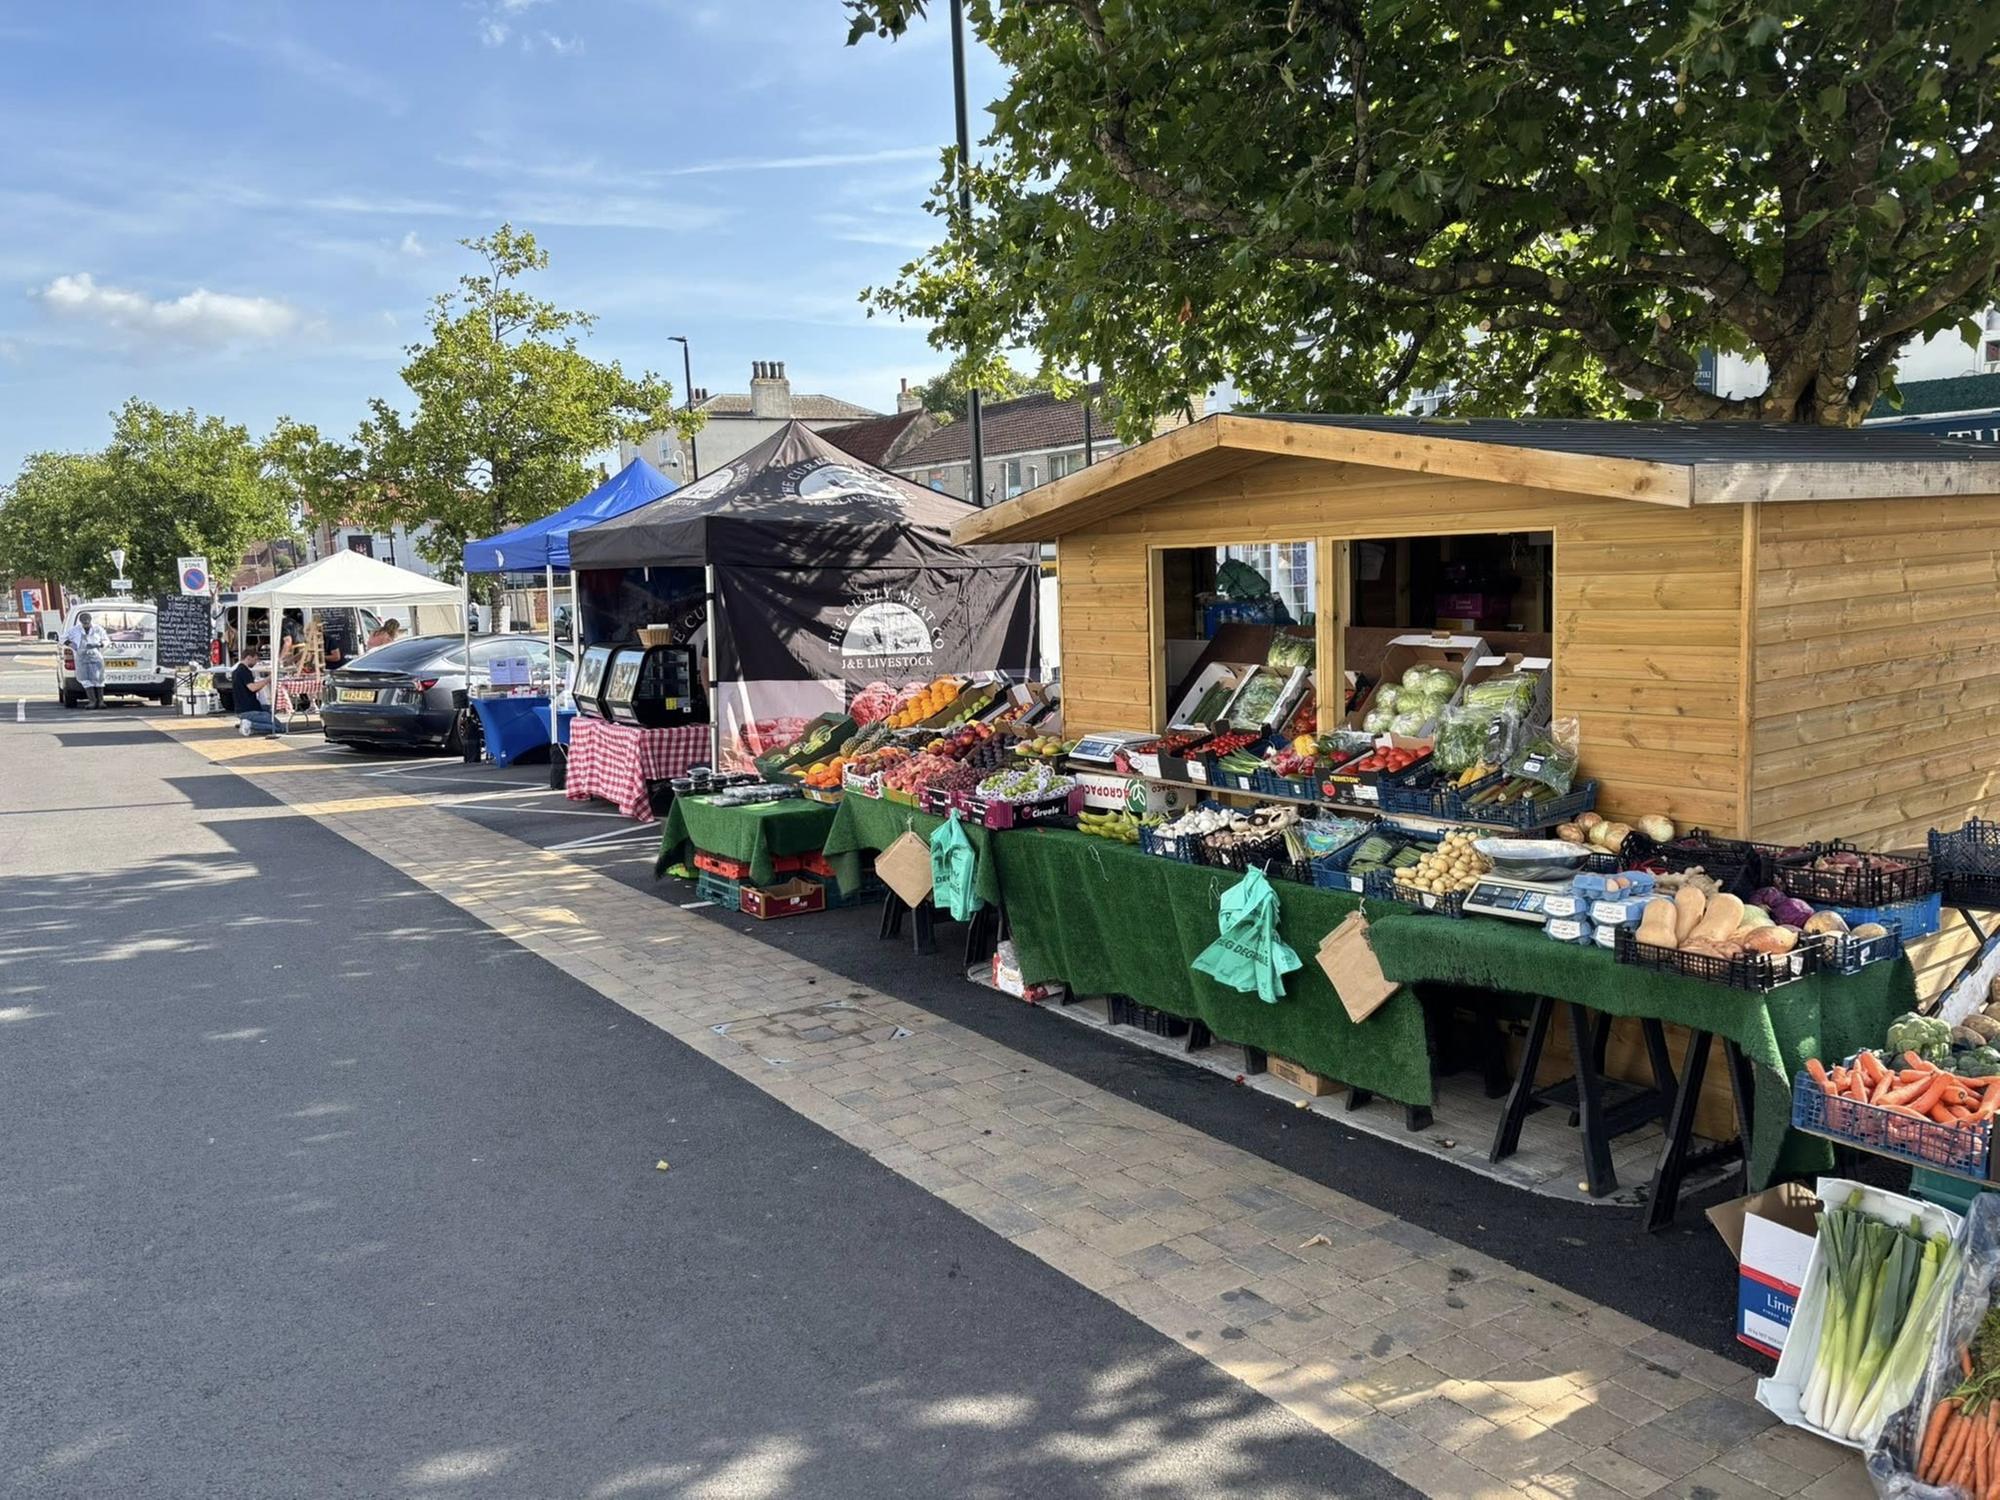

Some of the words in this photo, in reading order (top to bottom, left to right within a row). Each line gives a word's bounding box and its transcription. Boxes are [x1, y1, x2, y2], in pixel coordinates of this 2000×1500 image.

[828, 618, 847, 653] THE
[843, 586, 893, 617] CURLY
[898, 589, 936, 622] MEAT
[931, 626, 945, 650] CO
[841, 658, 865, 669] J&E
[867, 655, 934, 669] LIVESTOCK
